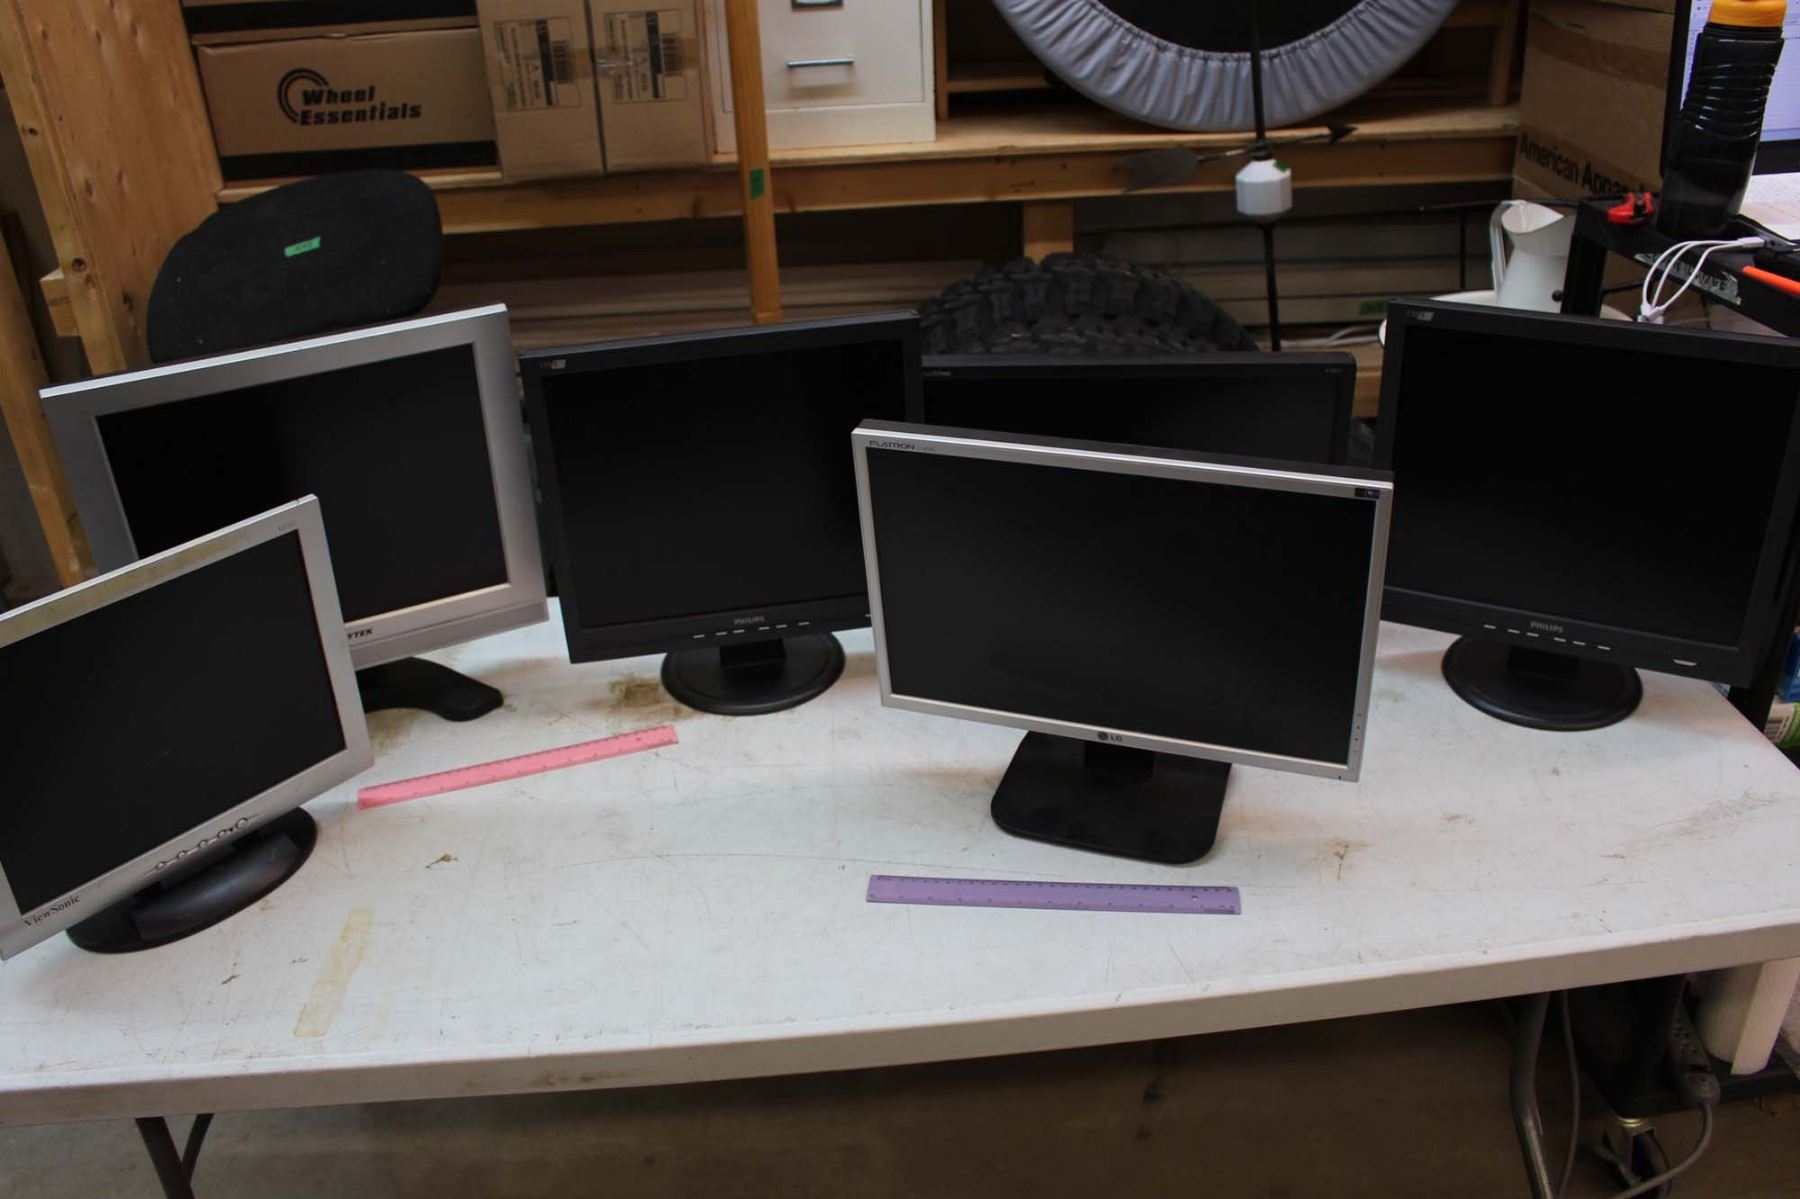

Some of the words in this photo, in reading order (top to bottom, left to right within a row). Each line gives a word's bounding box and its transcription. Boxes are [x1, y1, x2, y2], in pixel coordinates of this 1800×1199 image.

[302, 86, 375, 106] Wheel
[300, 102, 422, 126] Essentials
[1519, 132, 1579, 184] American
[868, 440, 915, 450] FLATRON
[1530, 620, 1563, 634] PHILIPS
[23, 894, 81, 926] ViewSonic
